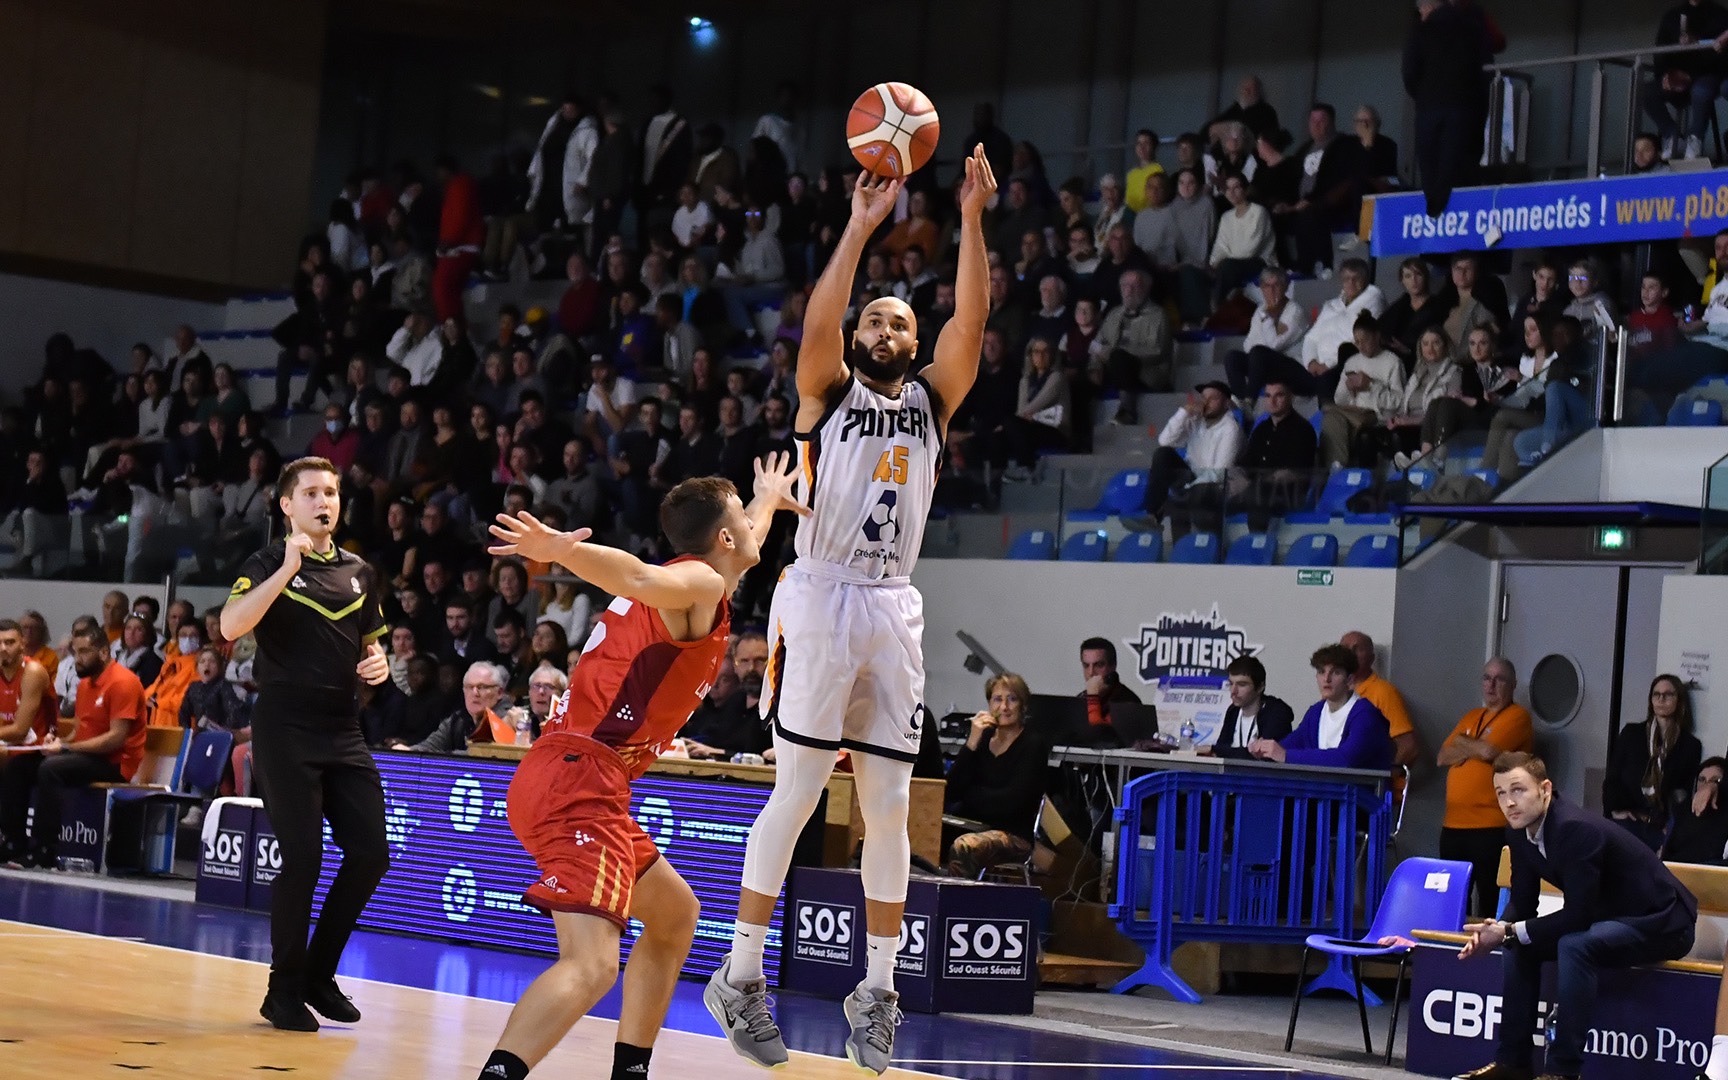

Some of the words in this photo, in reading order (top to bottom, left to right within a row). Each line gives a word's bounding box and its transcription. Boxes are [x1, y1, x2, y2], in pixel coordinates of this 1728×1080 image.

[1403, 211, 1469, 239] restez
[1475, 195, 1591, 235] connectés
[1600, 193, 1607, 227] !
[872, 445, 909, 485] 45
[854, 548, 878, 559] Crédi
[1141, 630, 1242, 670] POITIERS
[1169, 667, 1211, 677] BASKET
[76, 821, 97, 845] Pro
[257, 838, 283, 869] SO
[798, 905, 851, 944] SOS
[949, 923, 1023, 959] SOS
[797, 945, 808, 955] Sud
[809, 947, 825, 958] Ouest
[948, 964, 964, 974] Sud
[965, 964, 989, 975] Ouest
[990, 965, 1021, 975] Sécurité
[1584, 1028, 1648, 1060] mmo
[1655, 1027, 1709, 1067] Pro
